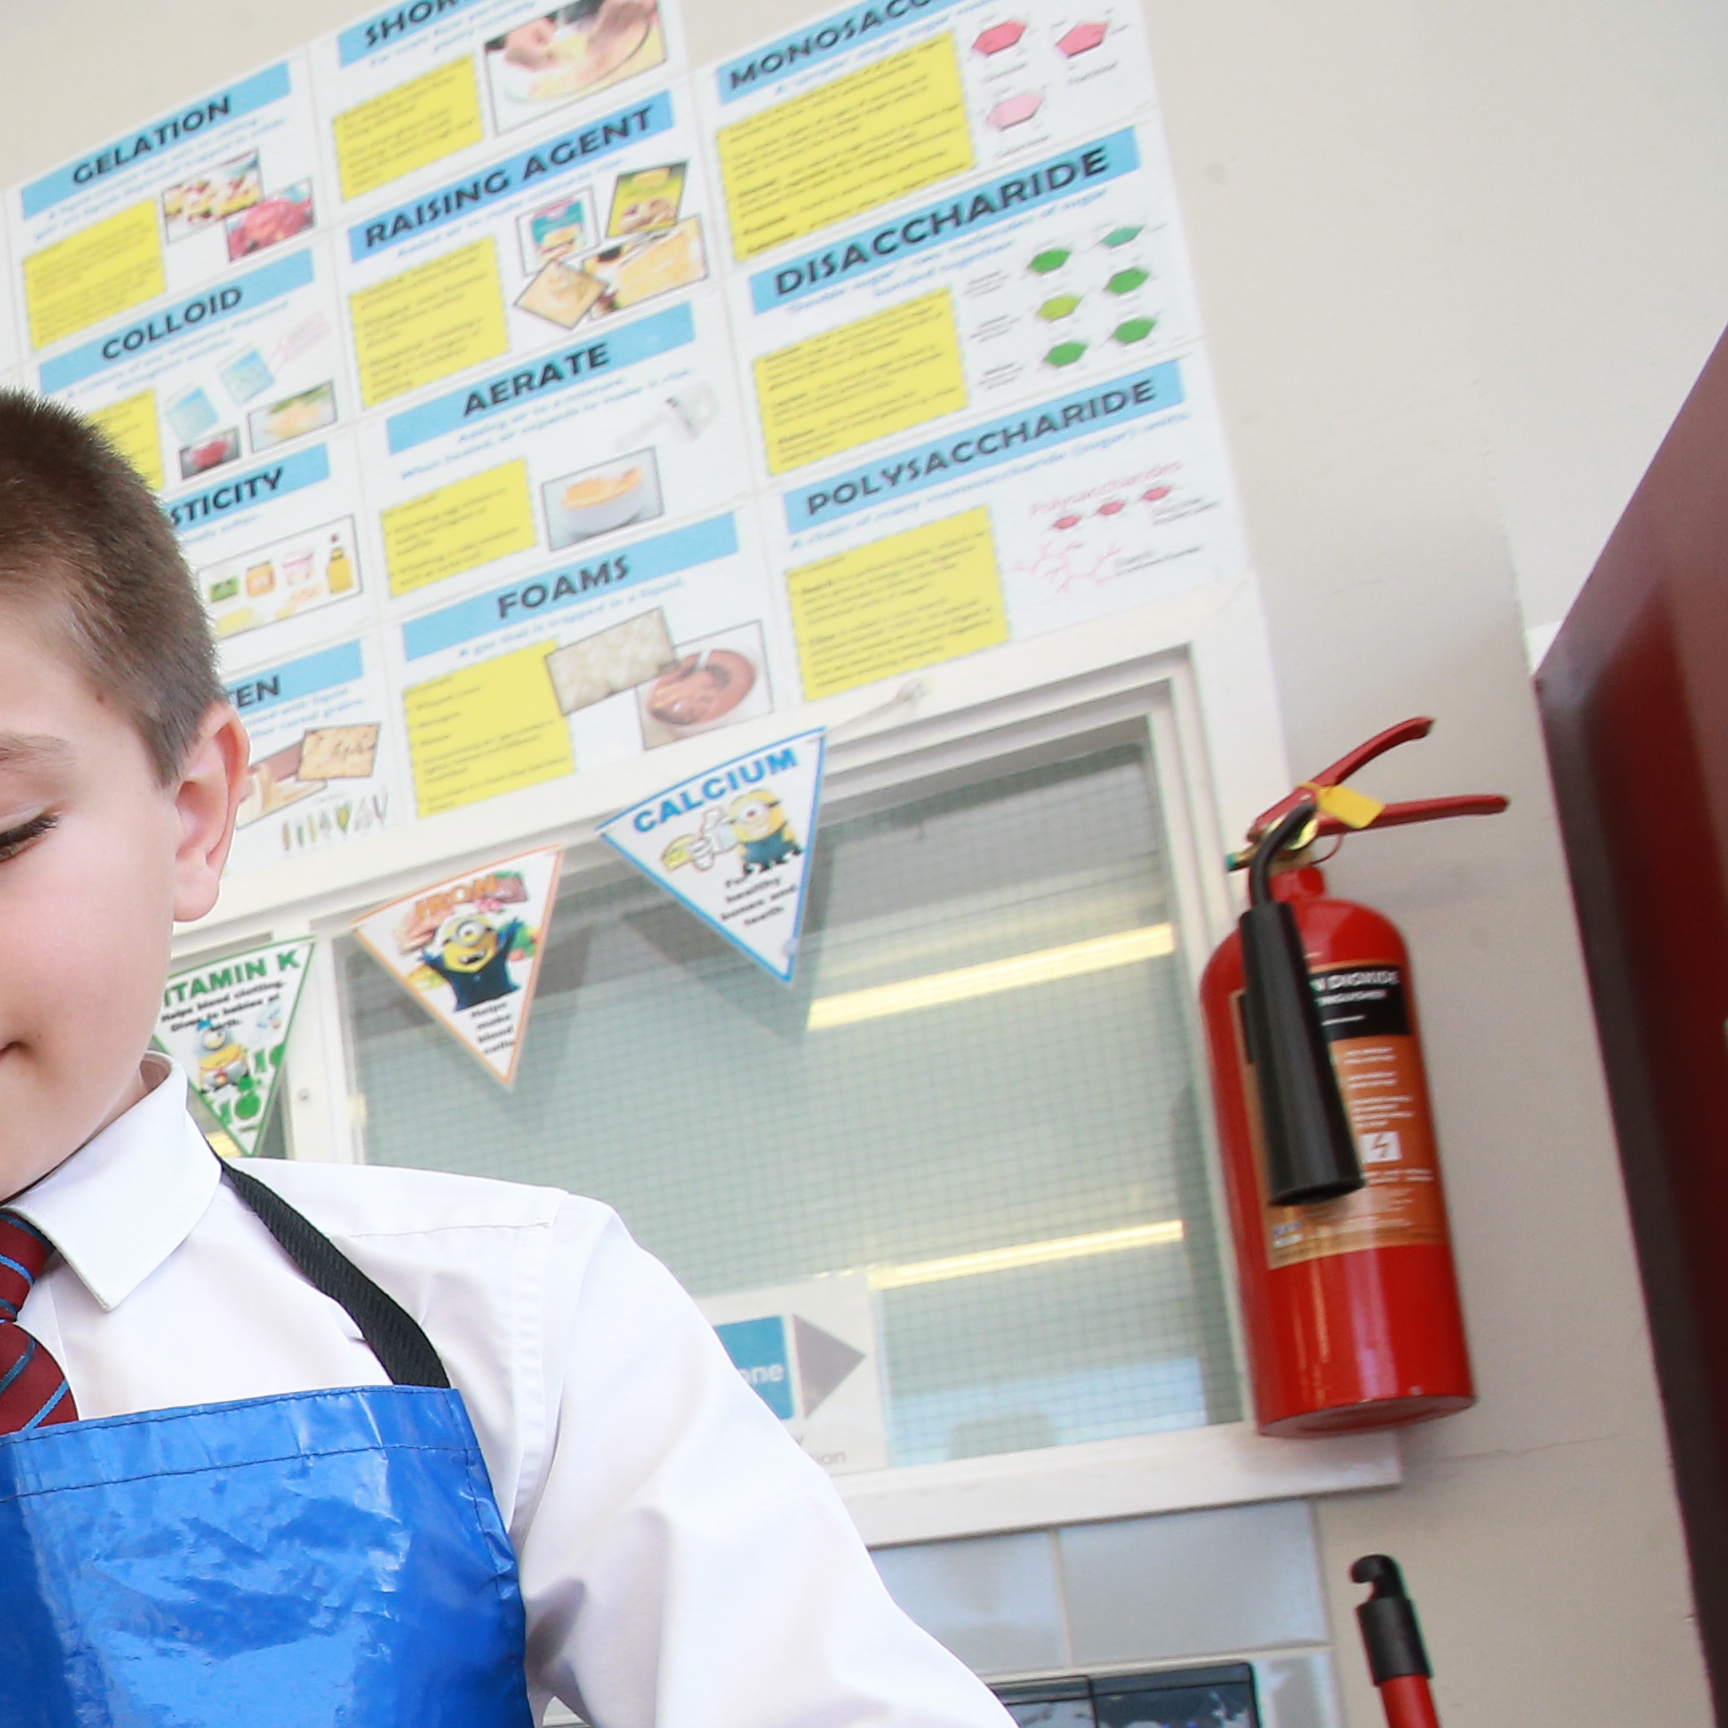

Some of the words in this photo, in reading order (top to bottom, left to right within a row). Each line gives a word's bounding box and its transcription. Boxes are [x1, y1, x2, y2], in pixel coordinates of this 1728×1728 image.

[365, 0, 456, 46] SHO
[729, 0, 935, 91] MONOSAC
[73, 95, 231, 185] GELATION
[365, 168, 512, 248] RAISING
[522, 105, 652, 182] AGENT
[774, 145, 1110, 296] DISACCHARIDE
[102, 288, 242, 360] COLLOID
[463, 342, 612, 418] AERATE
[806, 378, 1157, 516] POLYSACCHARIDE
[170, 467, 285, 527] STICITY
[495, 555, 630, 619] FOAMS
[634, 747, 798, 833] CALCIUM
[164, 959, 267, 1006] ITAMIN
[278, 949, 300, 971] K
